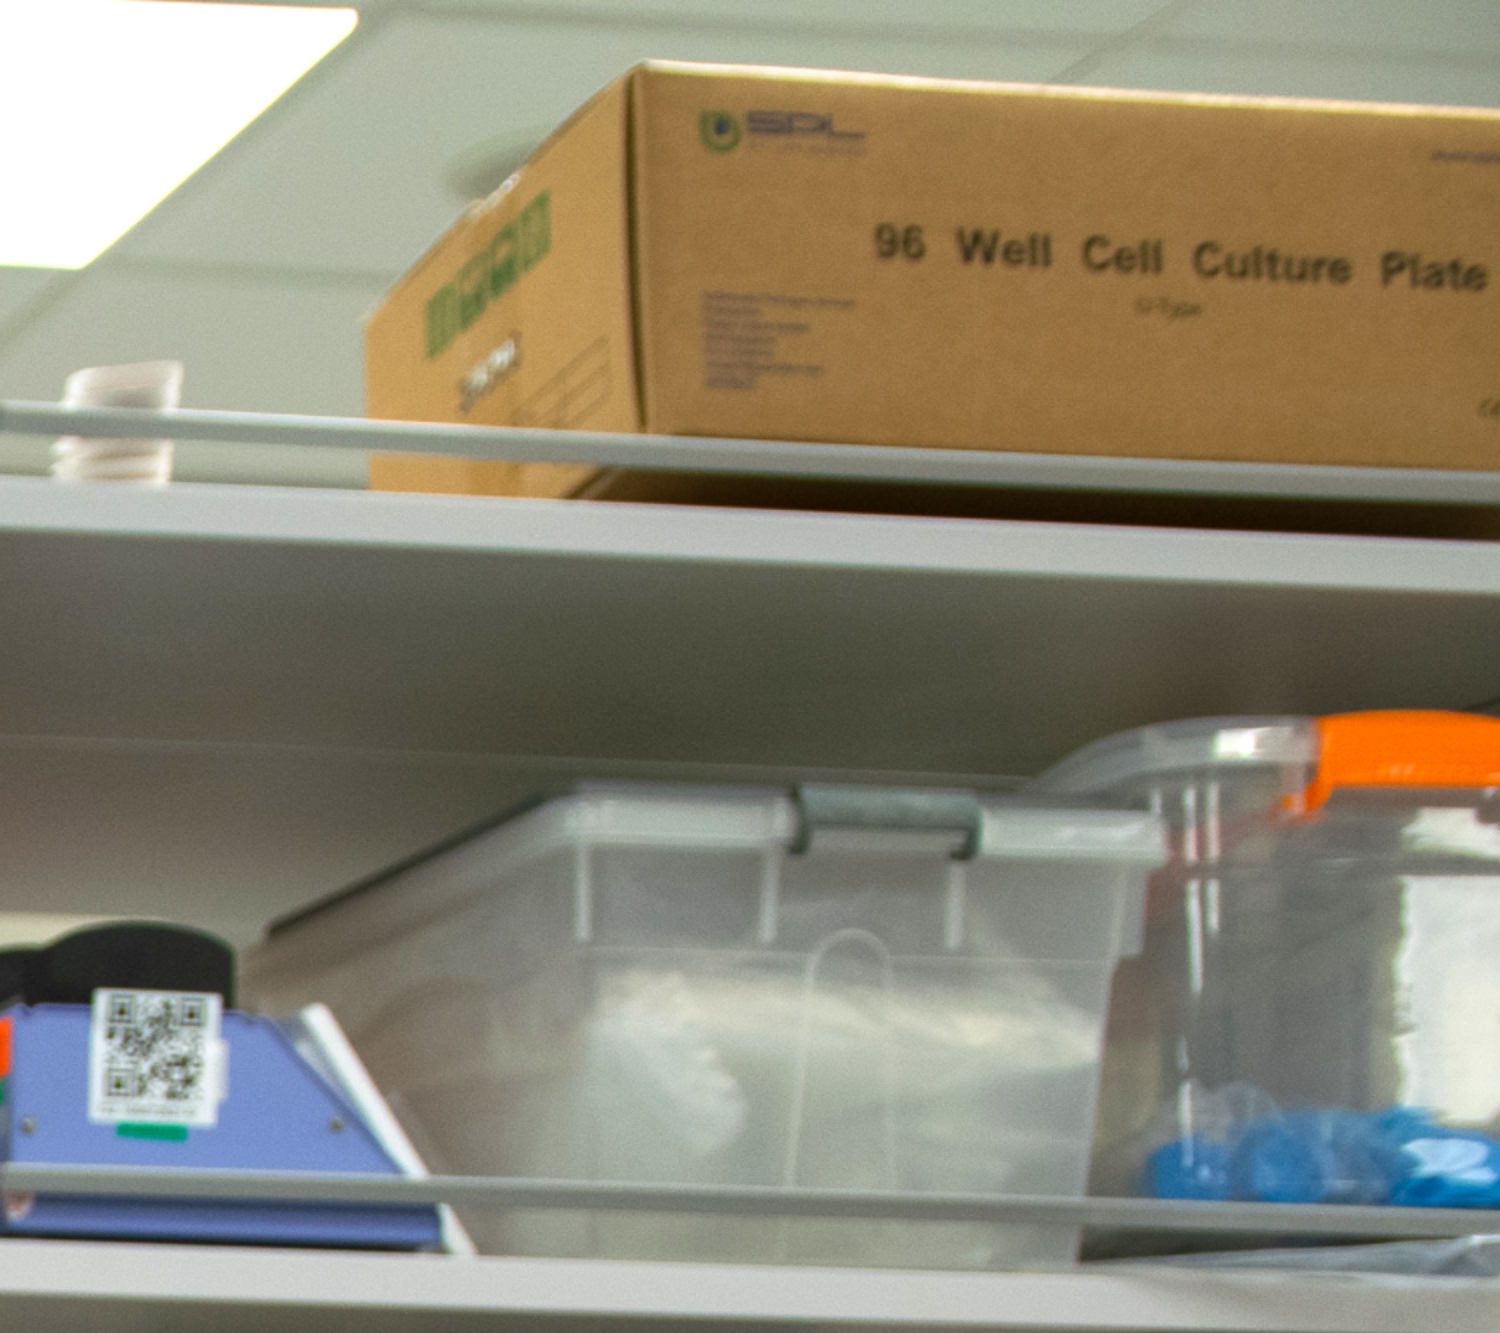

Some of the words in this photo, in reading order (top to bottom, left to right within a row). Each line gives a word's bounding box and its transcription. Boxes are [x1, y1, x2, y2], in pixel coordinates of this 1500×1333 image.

[874, 222, 927, 263] 96
[956, 226, 1053, 268] Well
[1082, 233, 1164, 275] Cell
[1192, 241, 1354, 286] Culture
[1381, 249, 1489, 294] Plate
